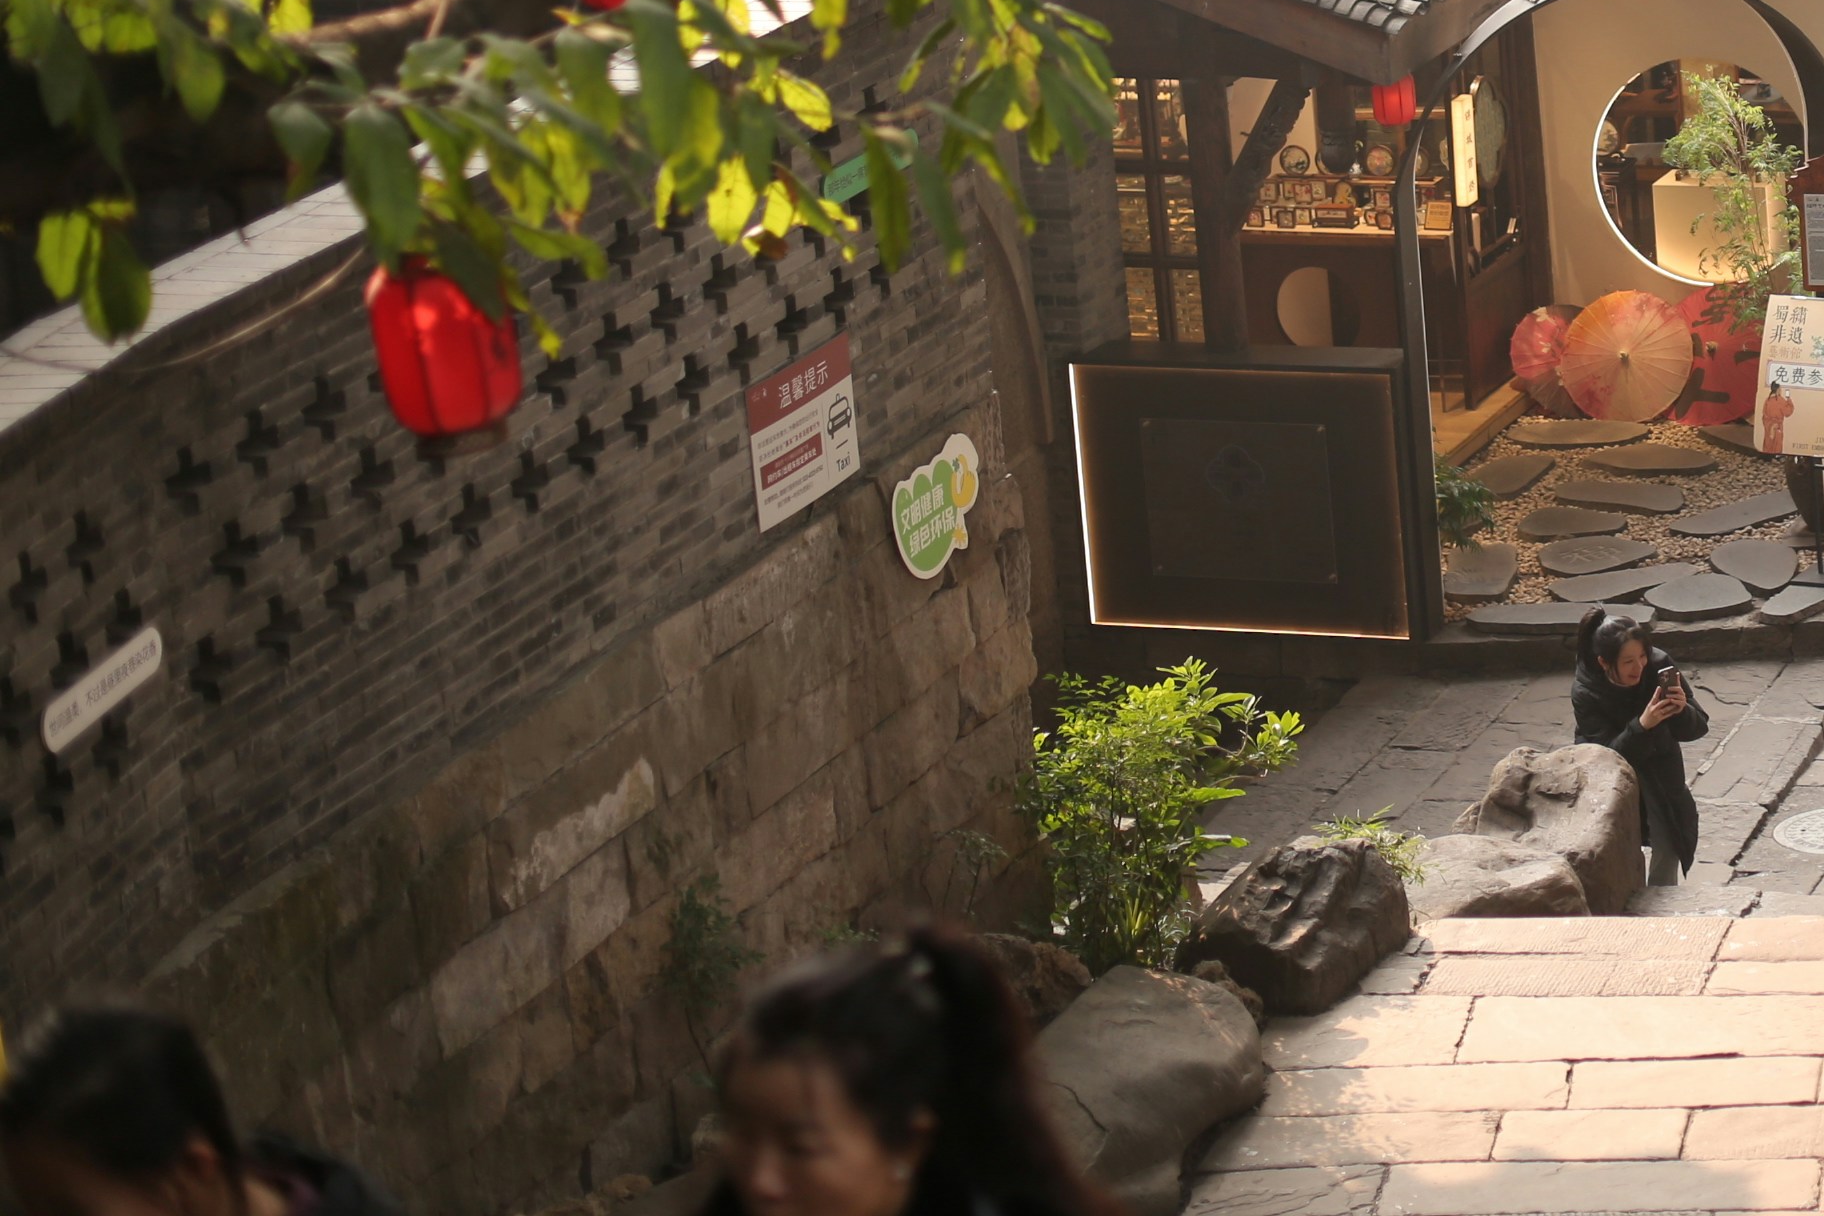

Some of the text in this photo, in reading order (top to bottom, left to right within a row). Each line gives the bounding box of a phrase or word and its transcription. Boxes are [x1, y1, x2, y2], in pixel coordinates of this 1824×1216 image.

[778, 360, 829, 409] 温馨提示
[836, 451, 851, 472] Taxi
[901, 483, 945, 535] 文明健康
[909, 505, 955, 558] 绿色环保
